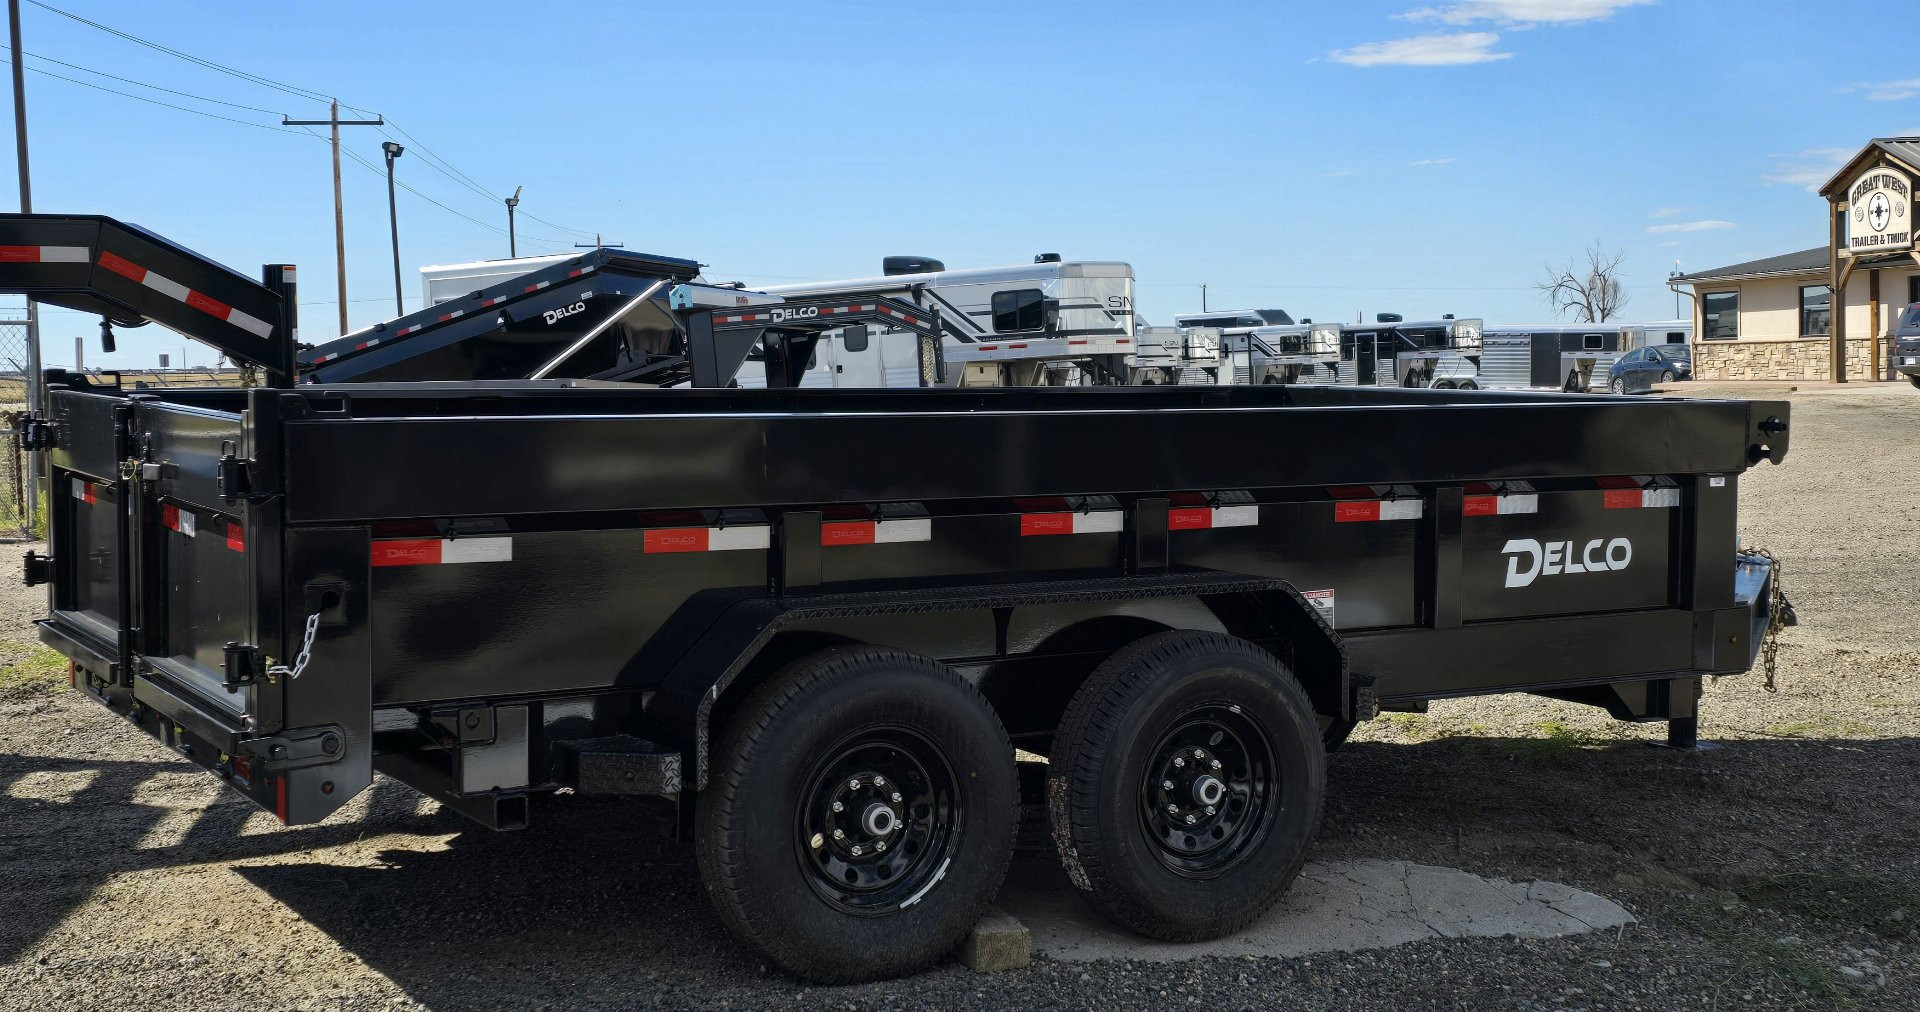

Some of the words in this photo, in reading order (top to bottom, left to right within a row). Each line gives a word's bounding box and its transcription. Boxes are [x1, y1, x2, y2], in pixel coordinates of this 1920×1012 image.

[1851, 174, 1880, 207] GREAT
[1881, 174, 1908, 201] WEST
[1851, 234, 1879, 248] TRAILER
[1880, 234, 1886, 245] &
[1886, 231, 1909, 245] TRUCK
[543, 301, 586, 325] DELCO
[770, 306, 818, 323] DELCO
[1501, 537, 1632, 588] DELCO
